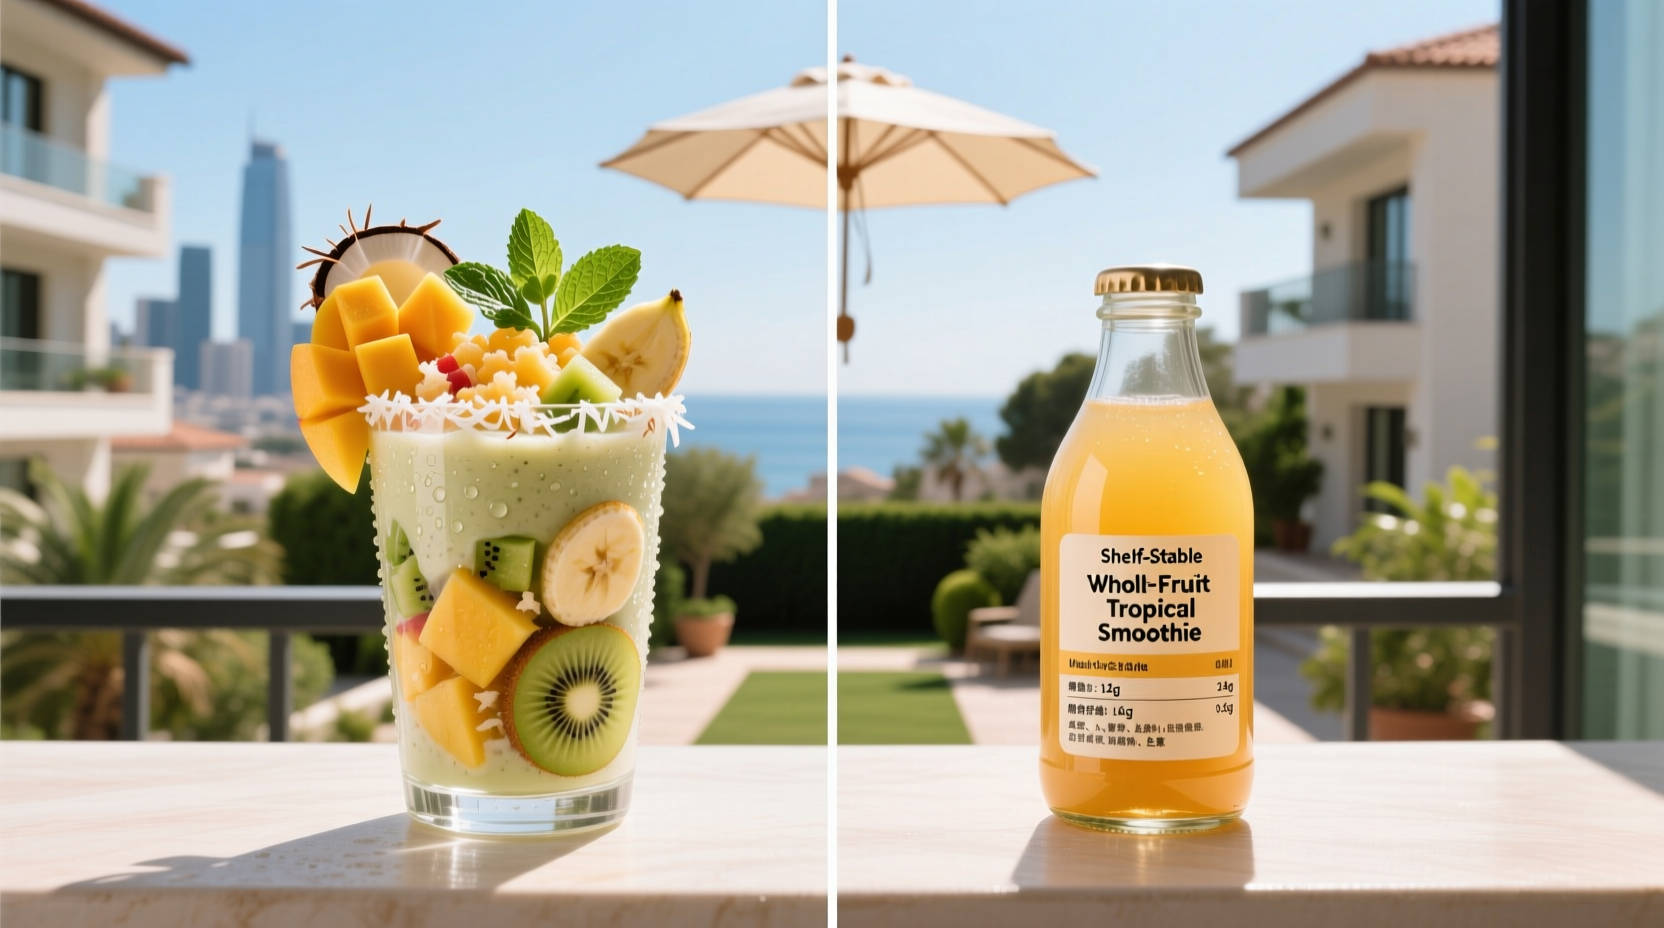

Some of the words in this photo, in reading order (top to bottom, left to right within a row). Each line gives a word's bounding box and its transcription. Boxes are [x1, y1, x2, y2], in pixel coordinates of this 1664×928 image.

[1100, 547, 1203, 564] Shelf-Stable
[1087, 574, 1211, 593] Wholl-Fruit
[1106, 597, 1196, 624] Tropical
[1098, 622, 1202, 642] Smoothie
[1101, 683, 1121, 697] 12g
